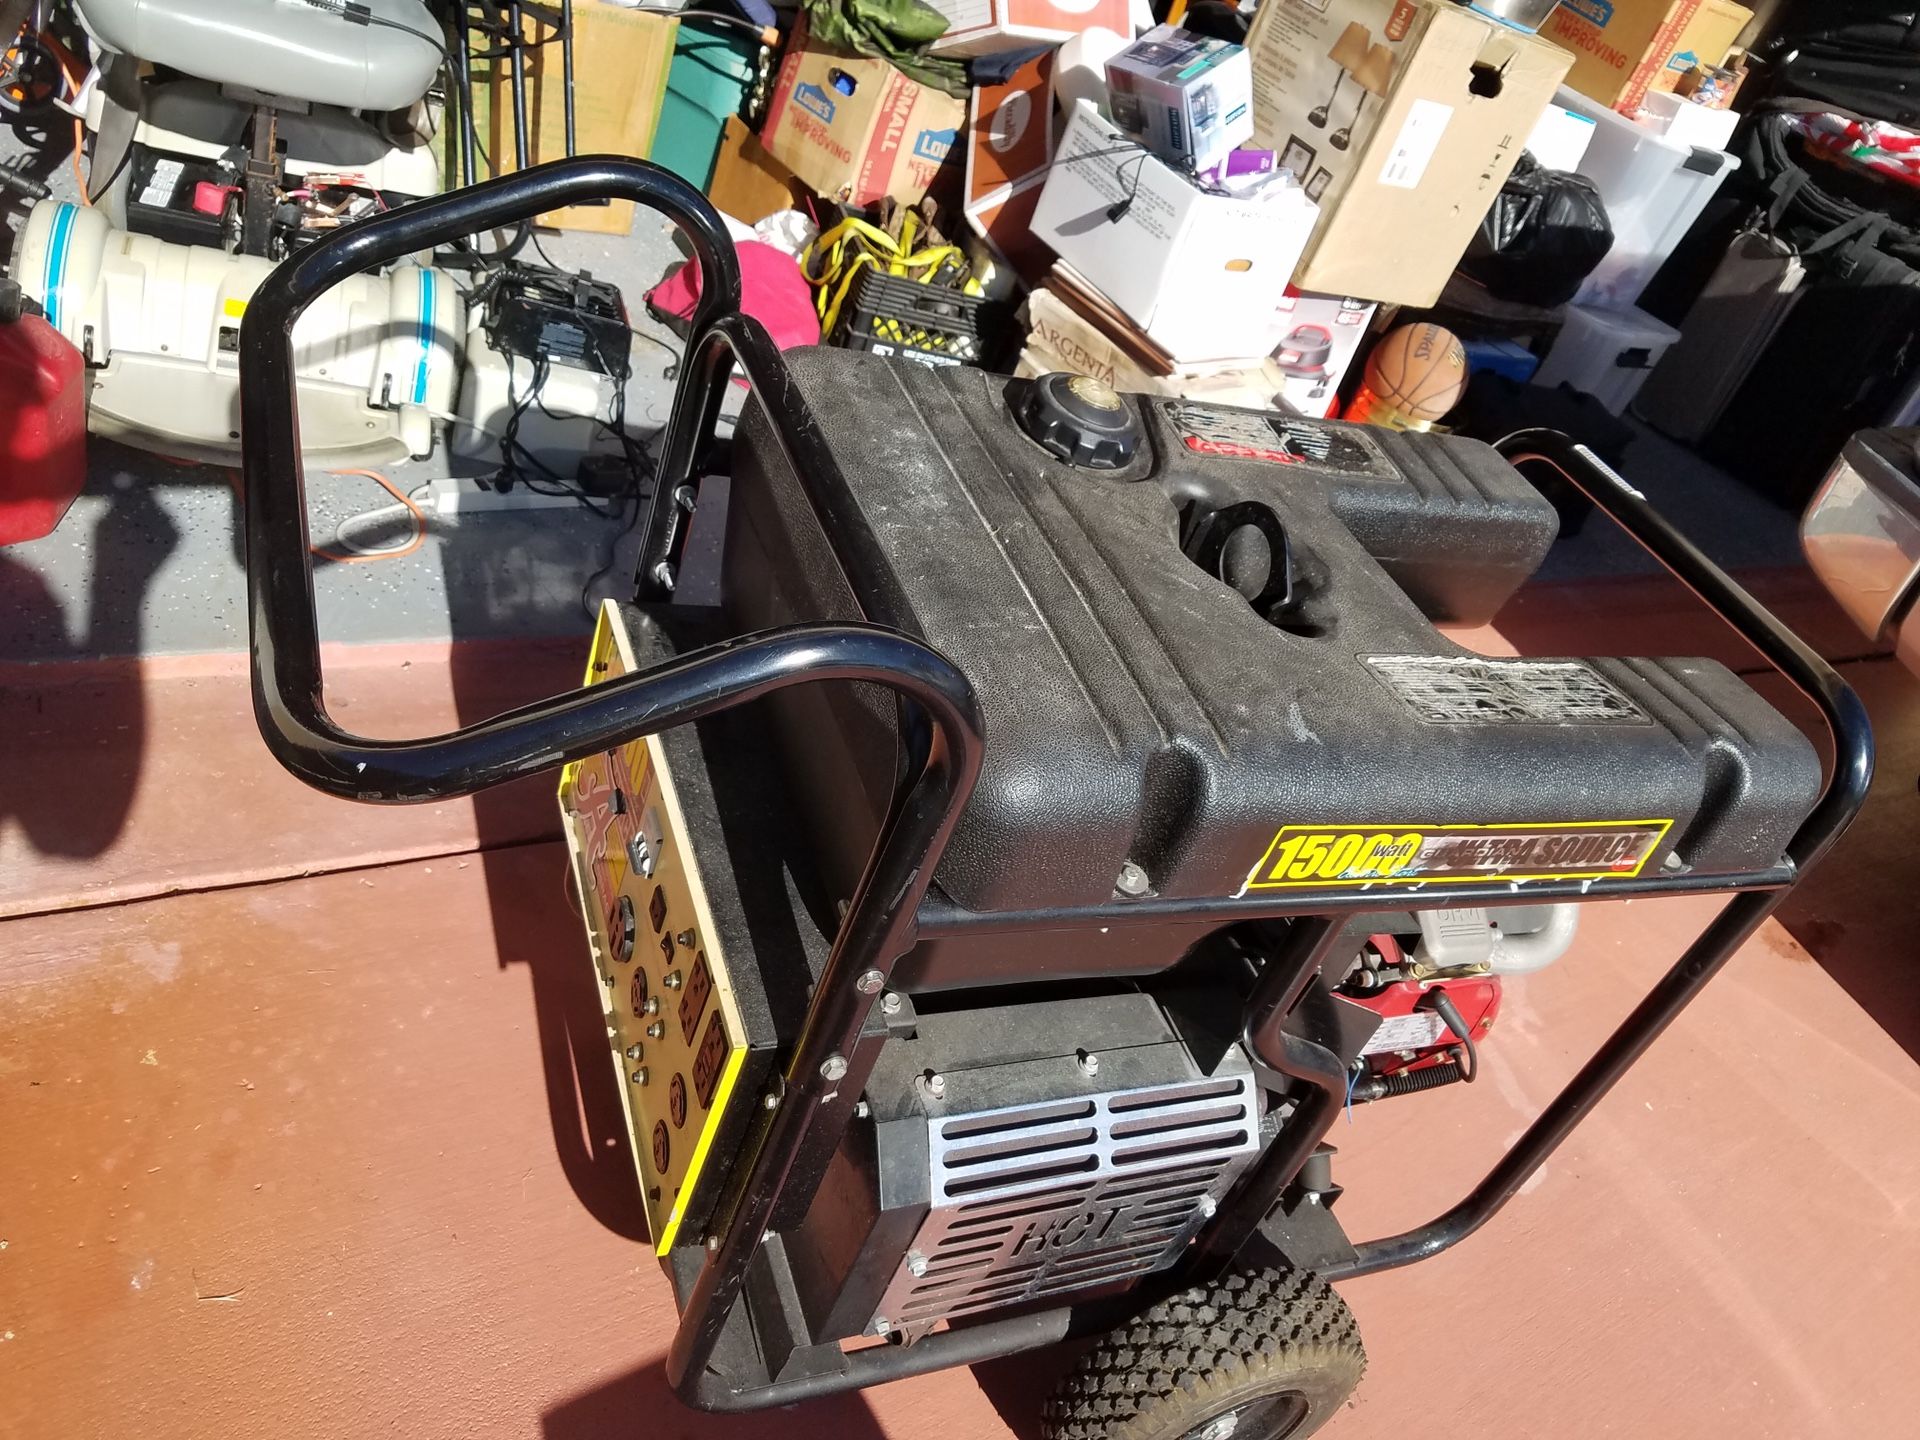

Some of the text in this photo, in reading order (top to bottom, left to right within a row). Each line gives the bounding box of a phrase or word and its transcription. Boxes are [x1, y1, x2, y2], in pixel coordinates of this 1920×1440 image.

[1554, 14, 1628, 69] IMPROVING
[793, 114, 852, 164] IMPROVING
[881, 80, 920, 153] SMALL
[1032, 318, 1116, 388] ARGENTA
[1268, 833, 1423, 879] 15000
[1534, 834, 1647, 866] SOURCE
[1010, 1204, 1134, 1258] HOT
